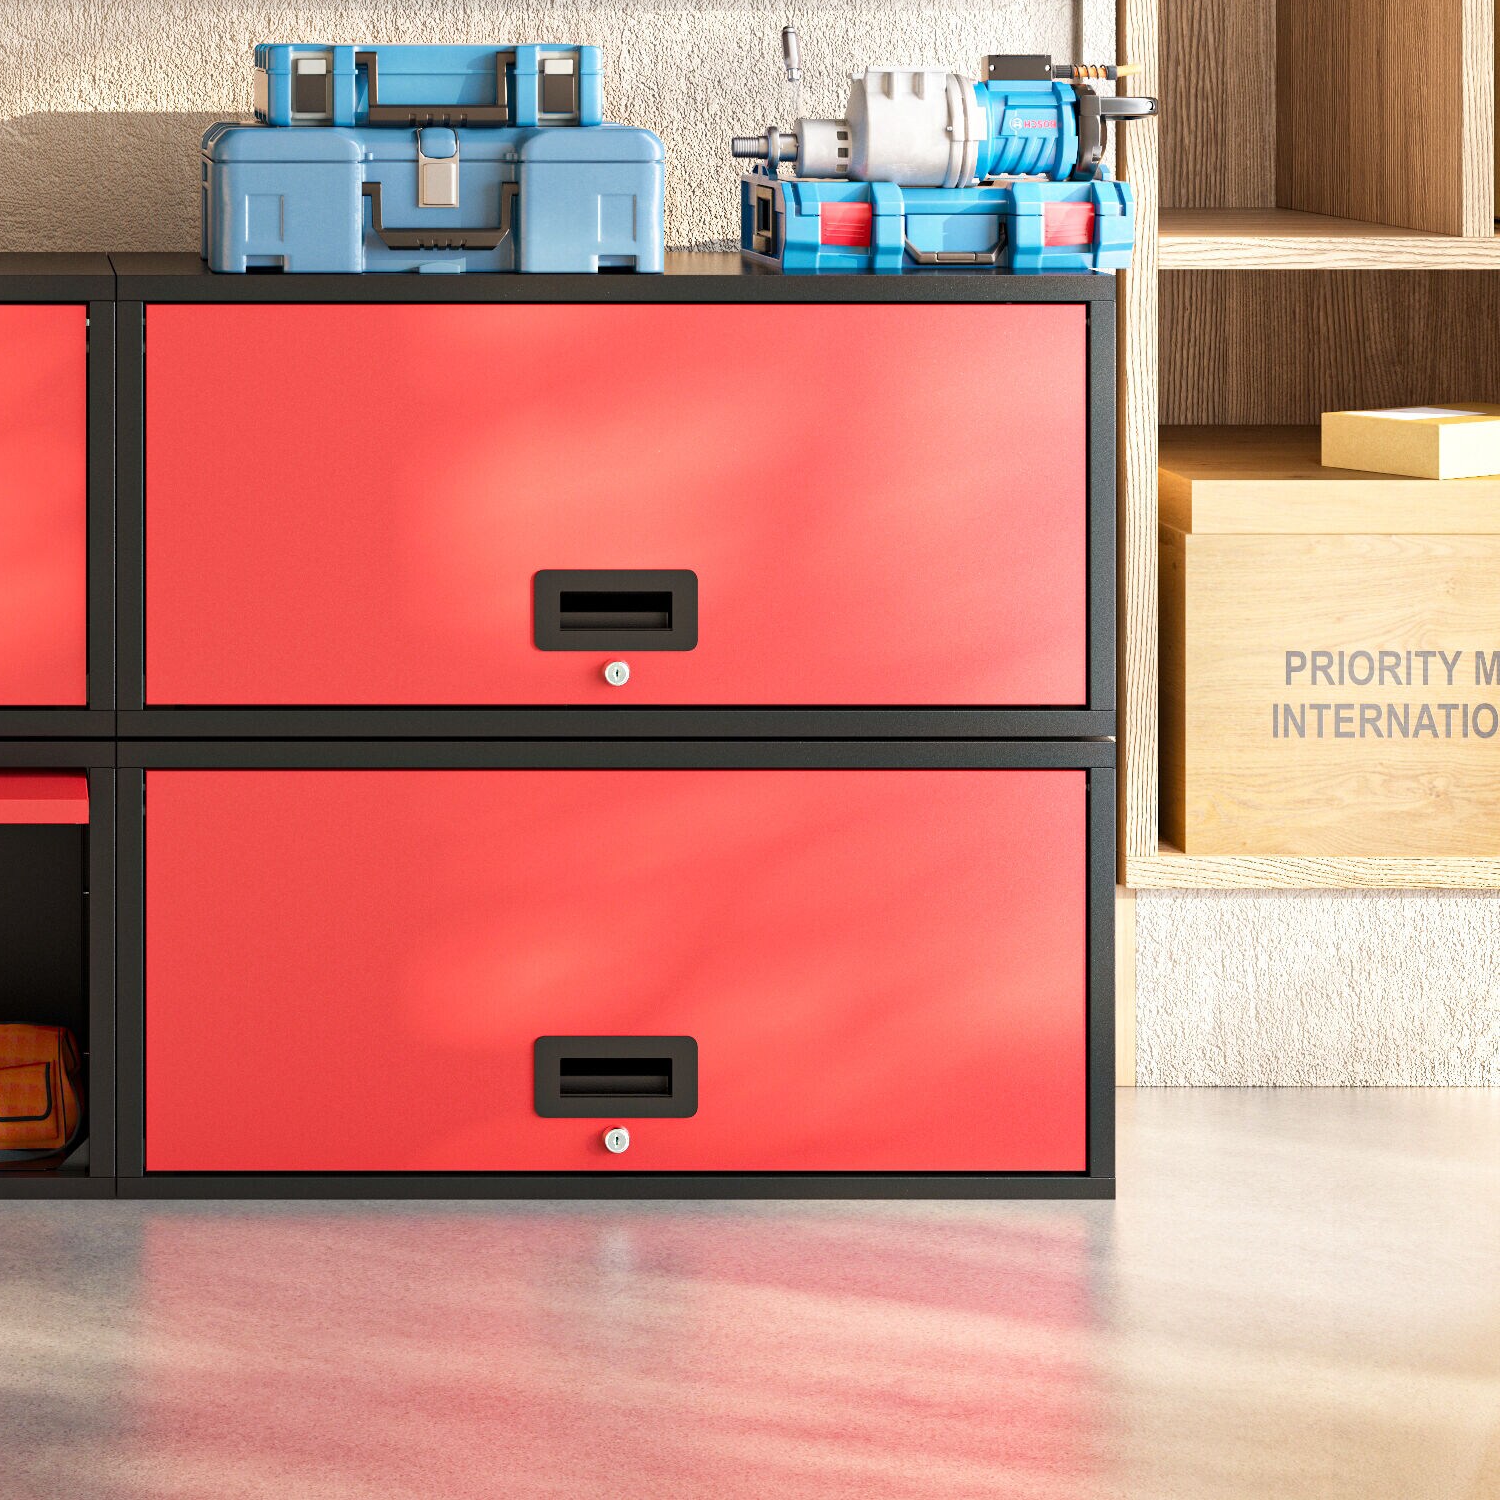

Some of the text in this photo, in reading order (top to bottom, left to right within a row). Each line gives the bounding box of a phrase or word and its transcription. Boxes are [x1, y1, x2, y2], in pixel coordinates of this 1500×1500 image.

[1024, 119, 1056, 128] BOSCH
[1285, 651, 1462, 685] PRIORITY
[1272, 703, 1498, 738] INTERNATIO
